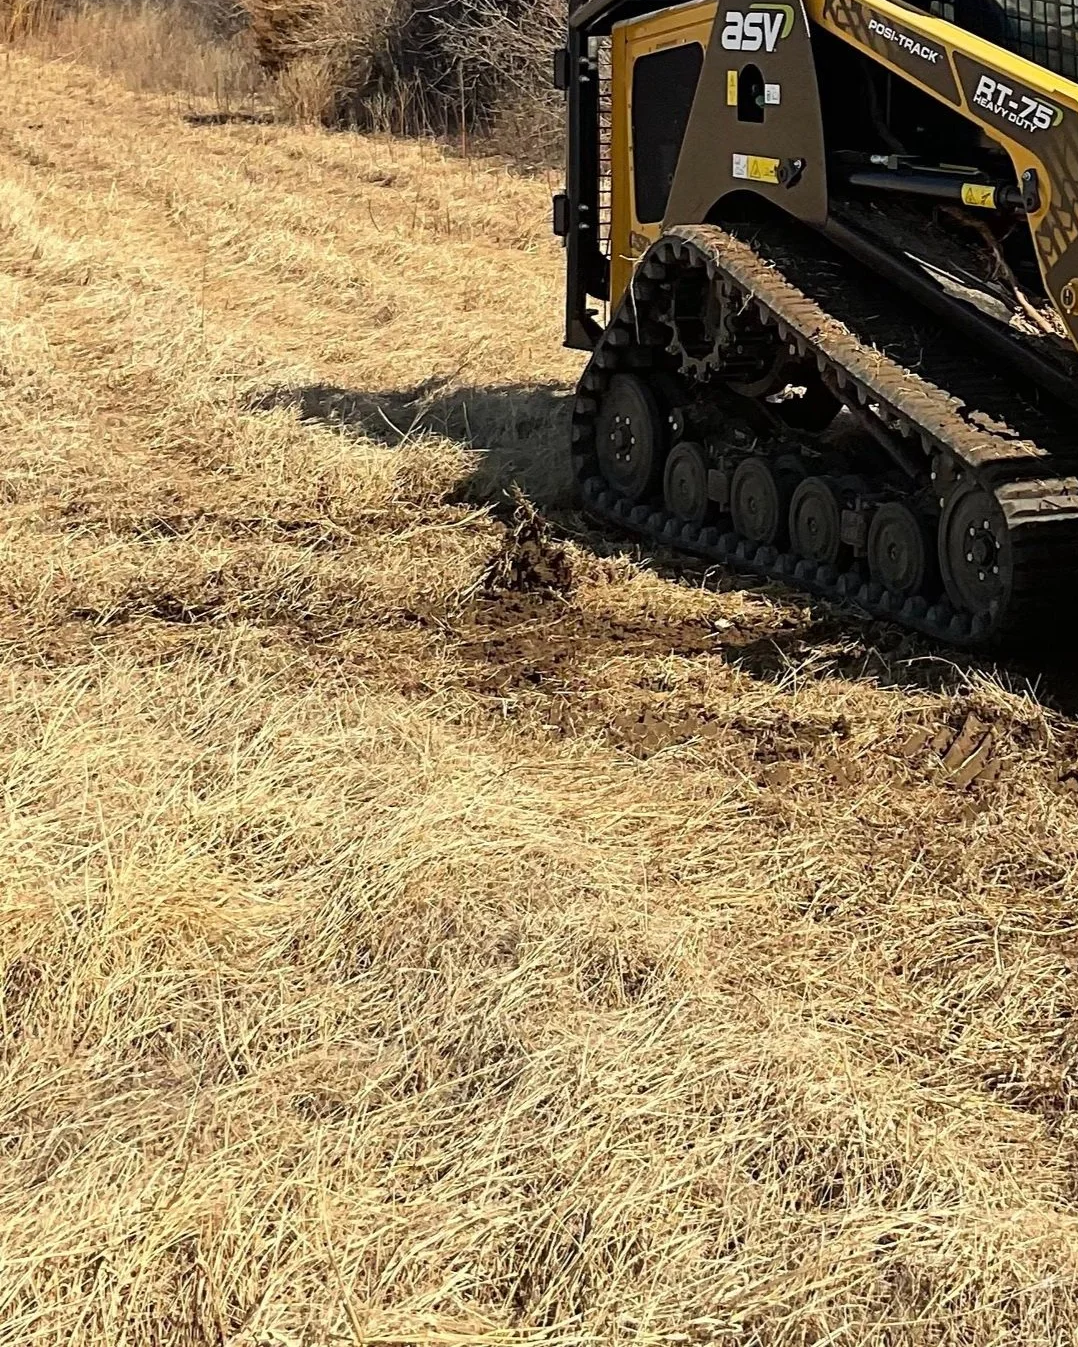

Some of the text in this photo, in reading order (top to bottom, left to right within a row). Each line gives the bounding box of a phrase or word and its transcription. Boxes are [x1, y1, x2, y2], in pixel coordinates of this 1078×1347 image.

[868, 19, 939, 63] POSI-TRACK
[973, 93, 1037, 132] HEAVY DUTY
[976, 75, 1054, 129] RT-75
